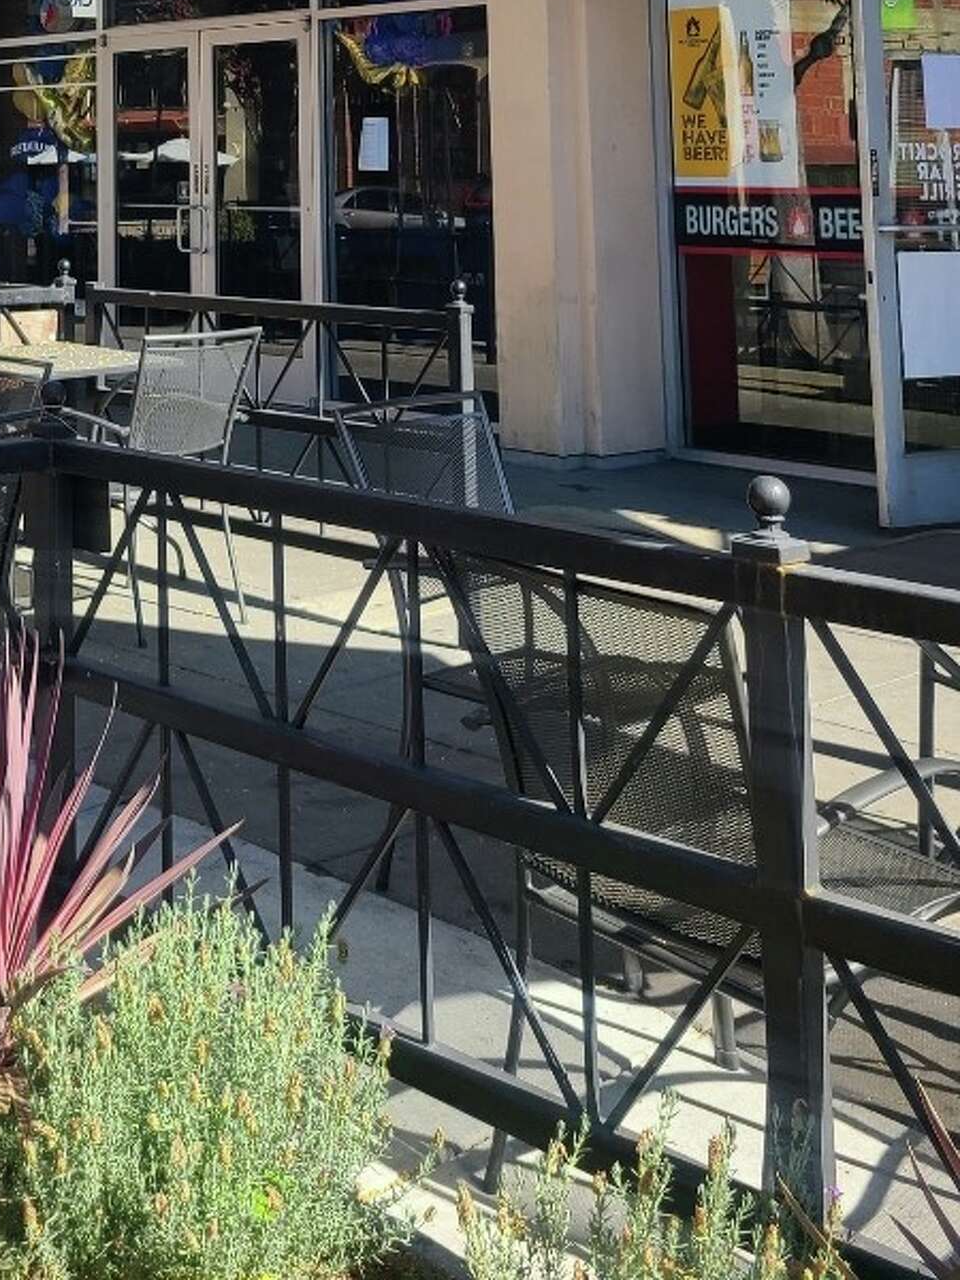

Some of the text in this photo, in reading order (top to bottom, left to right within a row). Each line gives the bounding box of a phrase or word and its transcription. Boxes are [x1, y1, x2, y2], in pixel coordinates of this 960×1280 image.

[682, 114, 707, 129] WE
[682, 130, 727, 145] HAVE
[683, 146, 729, 161] BEER!
[685, 205, 861, 239] BURGERS BEE
